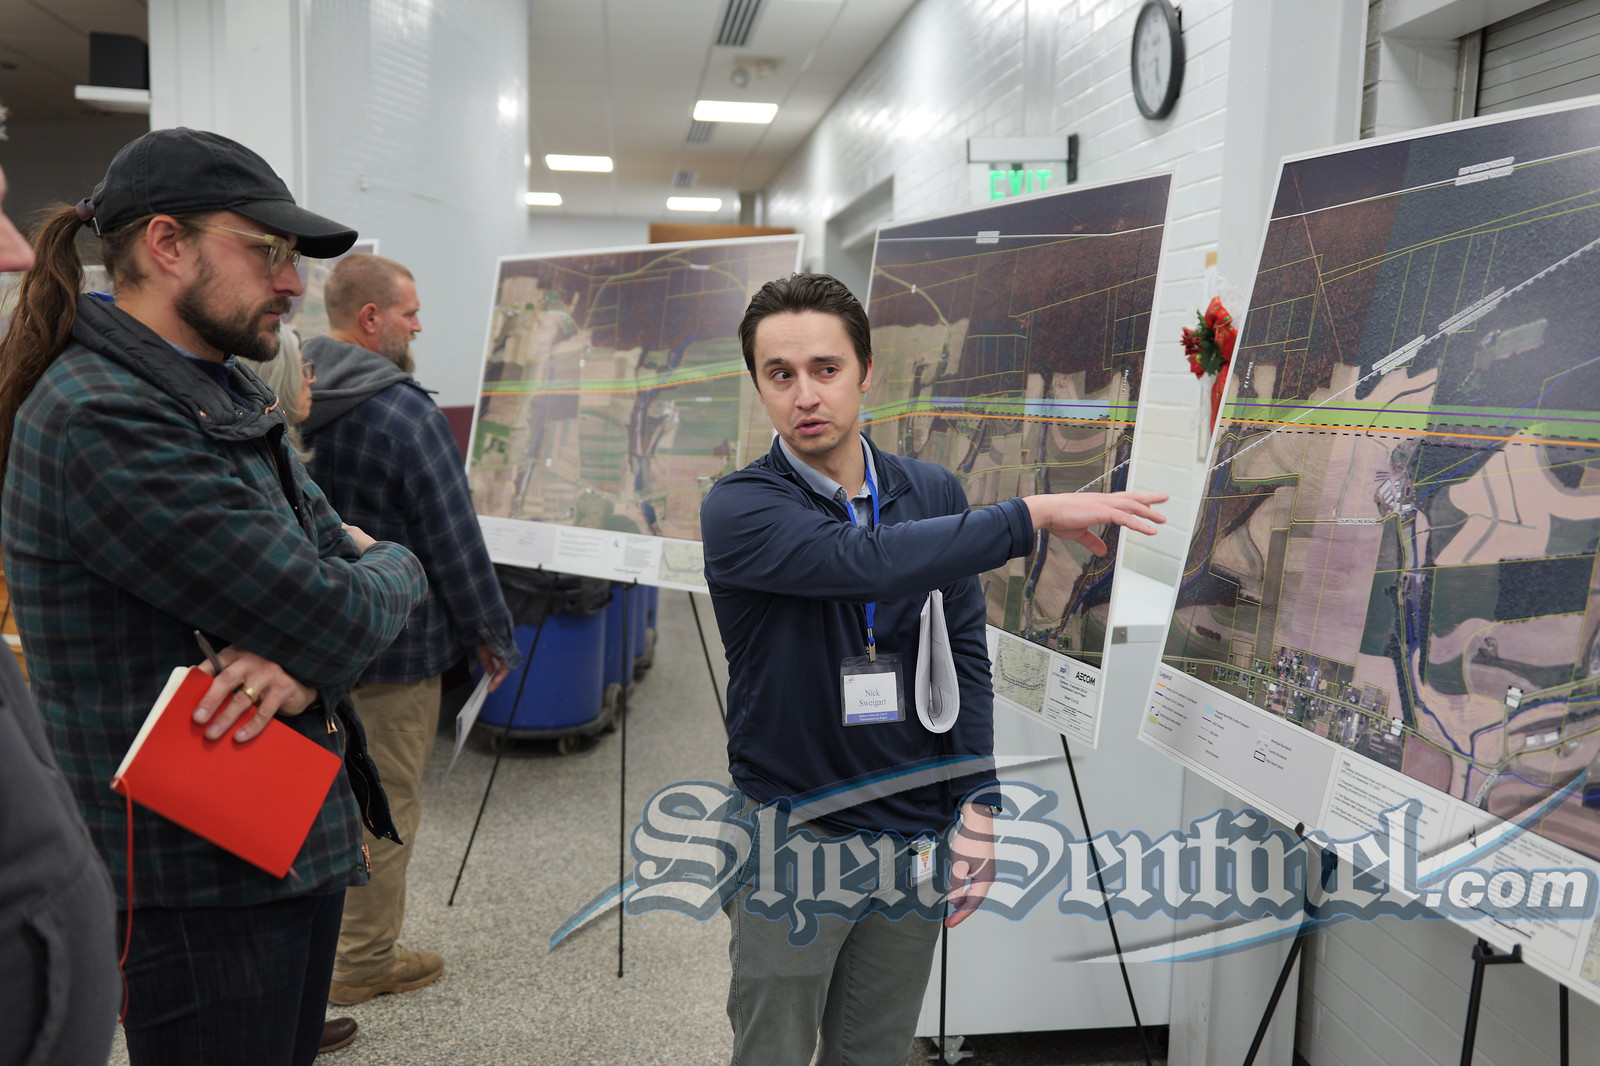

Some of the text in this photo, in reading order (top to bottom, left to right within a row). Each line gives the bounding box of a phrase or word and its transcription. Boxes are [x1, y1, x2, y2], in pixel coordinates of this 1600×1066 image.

[990, 170, 1052, 201] EXIT
[1075, 671, 1096, 686] AECOM
[865, 689, 881, 698] Nick
[859, 699, 887, 708] Sweigart
